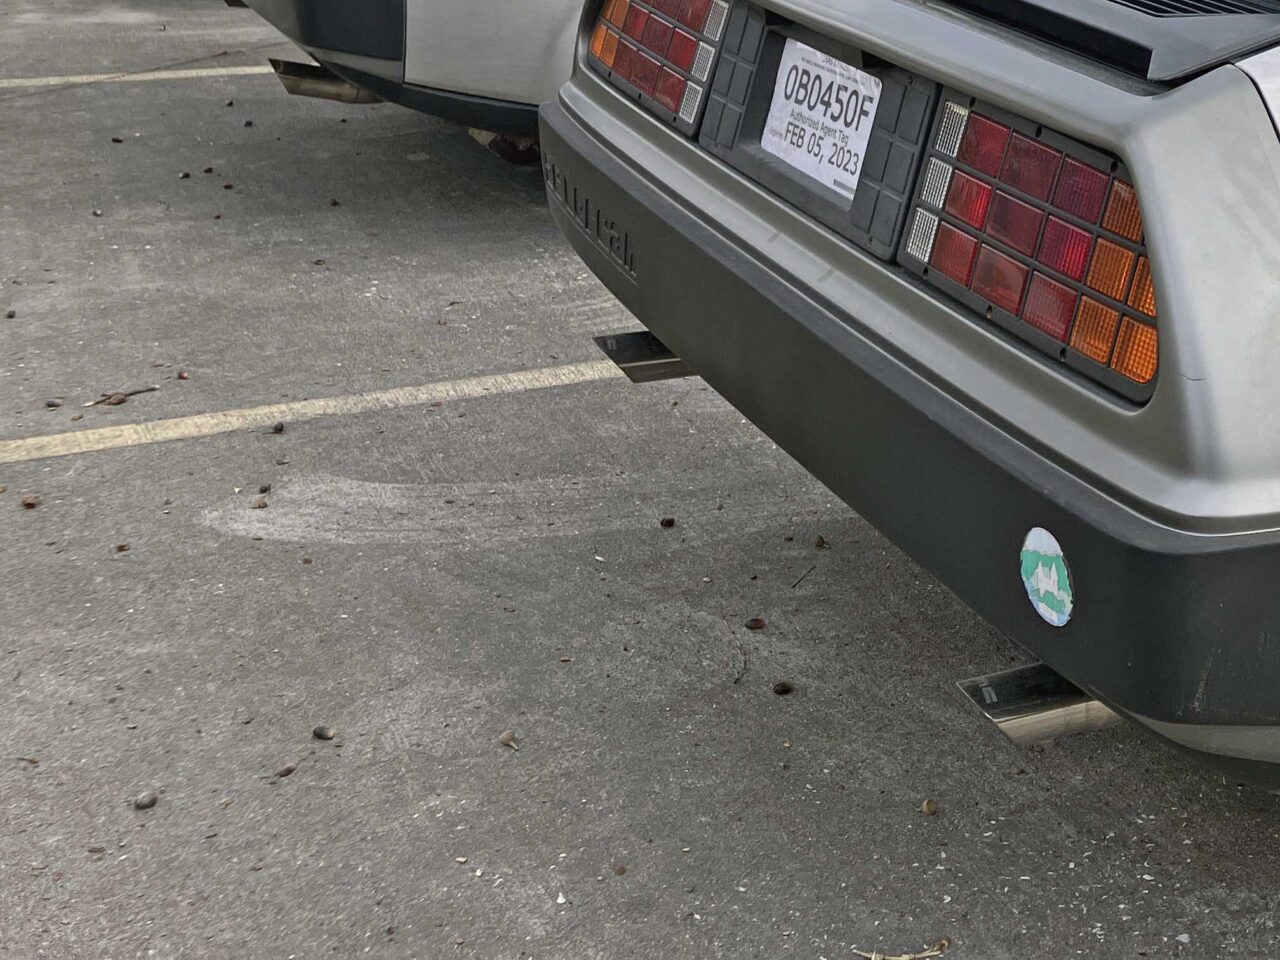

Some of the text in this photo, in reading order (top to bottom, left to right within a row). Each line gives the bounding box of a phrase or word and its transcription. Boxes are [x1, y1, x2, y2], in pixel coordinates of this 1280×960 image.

[784, 121, 859, 176] FEB 05, 2023
[790, 108, 849, 147] Authorized Agent Tag
